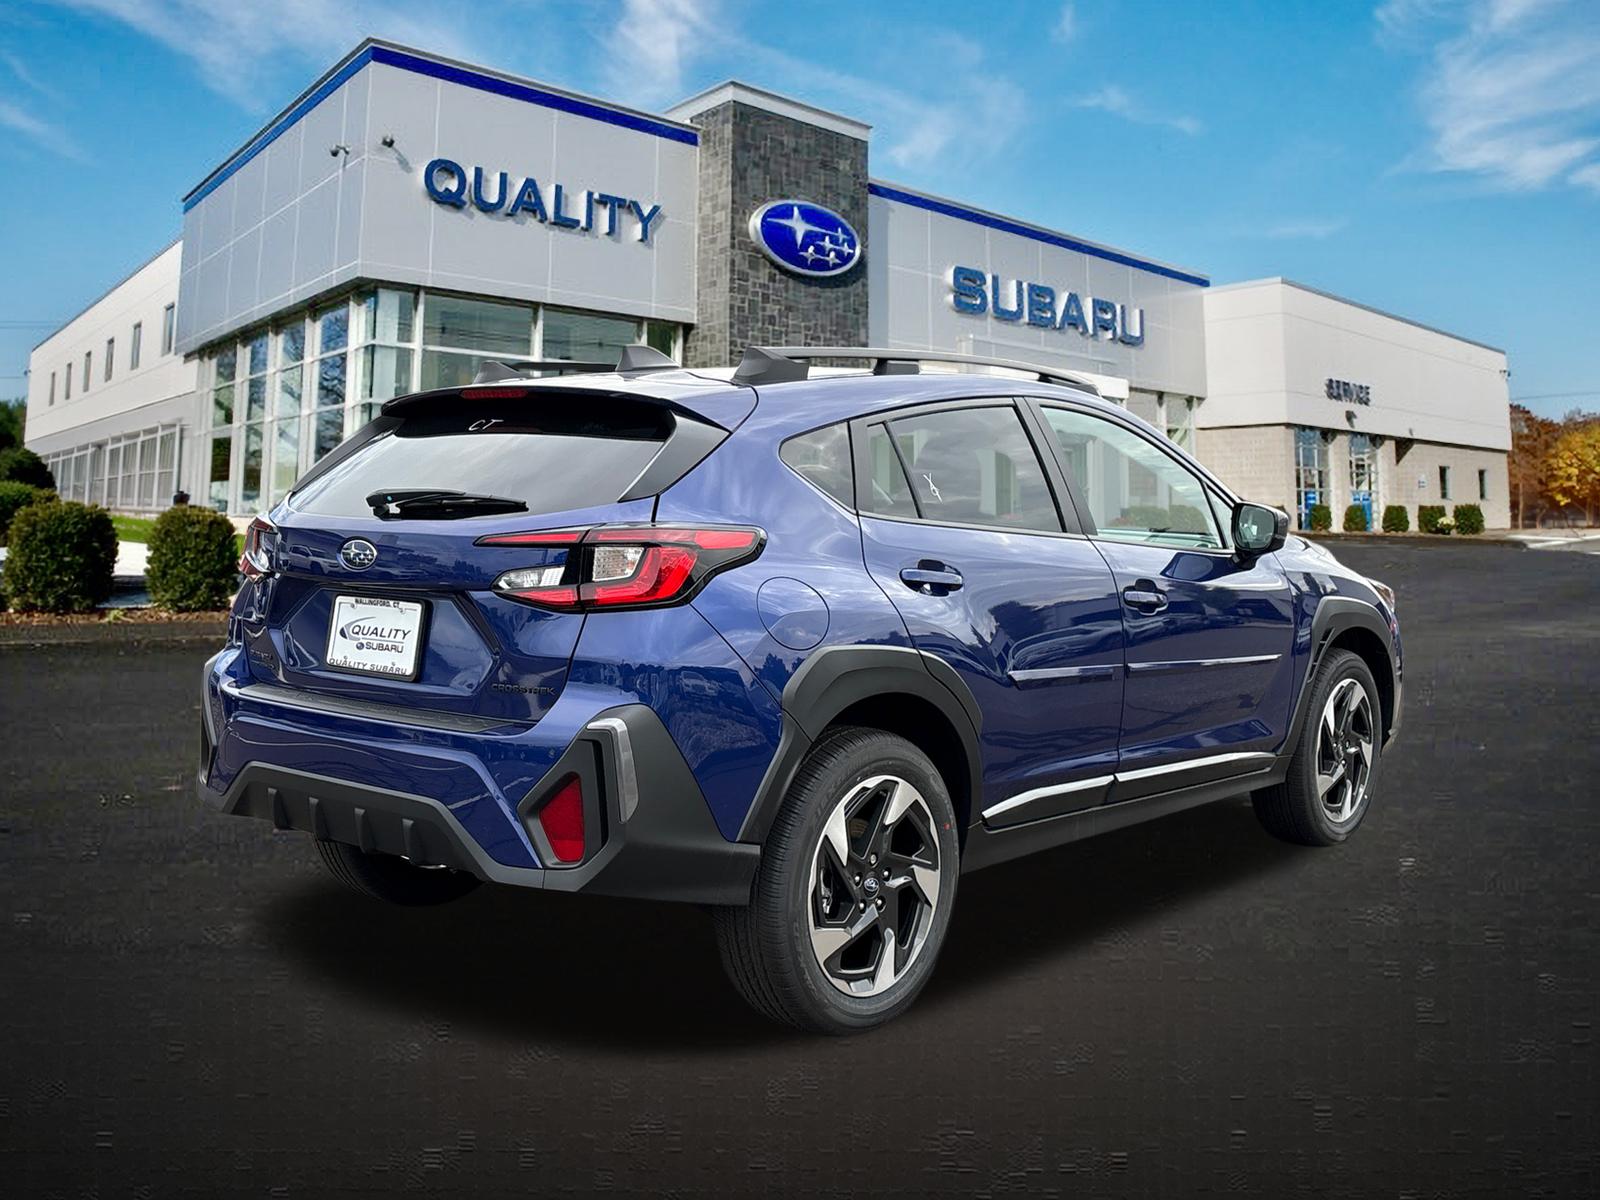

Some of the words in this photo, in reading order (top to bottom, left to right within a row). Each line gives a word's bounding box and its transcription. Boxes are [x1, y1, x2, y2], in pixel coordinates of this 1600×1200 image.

[424, 158, 663, 242] QUALITY
[952, 265, 1145, 346] SUBARU
[351, 624, 411, 640] QUALITY
[365, 641, 404, 654] SUBARU
[328, 657, 368, 670] QUALITY
[370, 663, 407, 675] SUBARU
